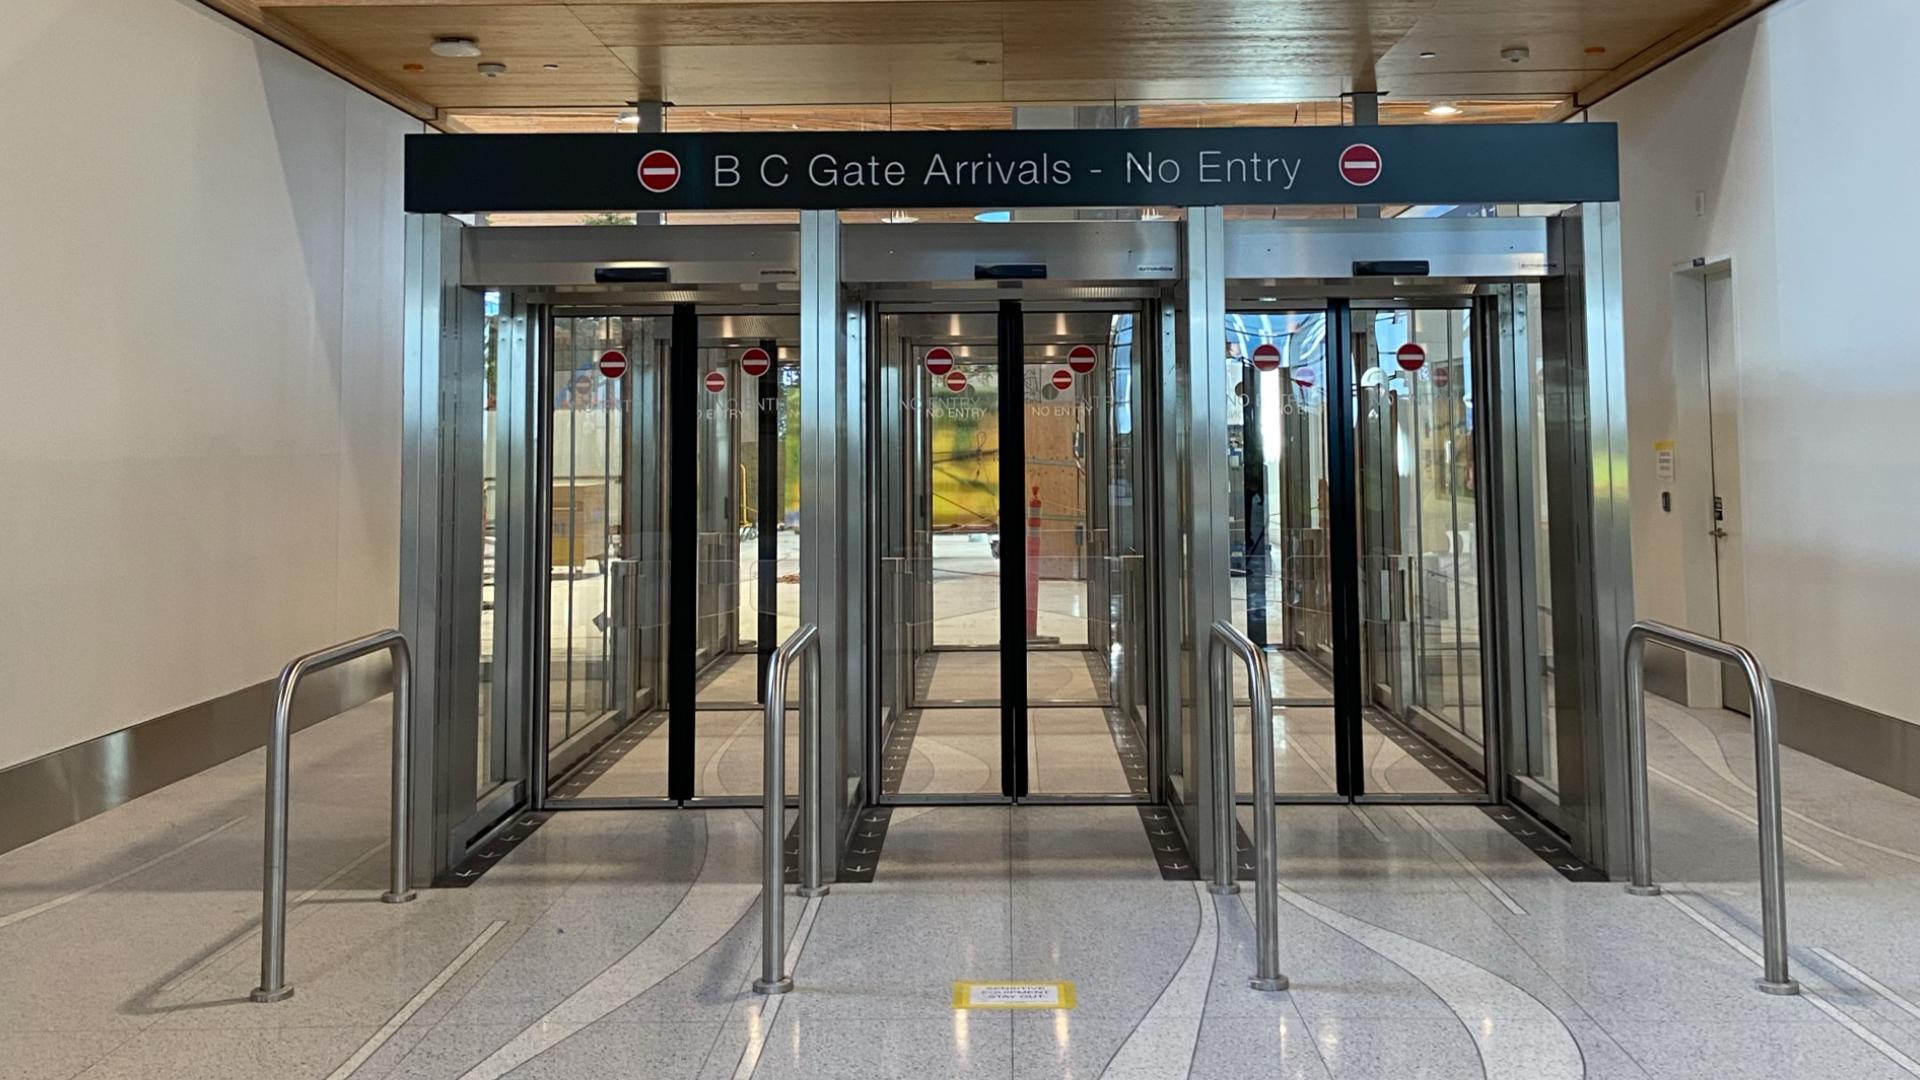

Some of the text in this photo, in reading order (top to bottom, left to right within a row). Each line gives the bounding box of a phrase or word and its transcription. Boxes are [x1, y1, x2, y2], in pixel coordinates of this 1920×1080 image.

[714, 155, 741, 187] B
[760, 154, 789, 187] C
[808, 154, 905, 187] Gate
[923, 152, 1072, 185] Arrivals
[1126, 151, 1180, 183] No
[1199, 150, 1301, 190] Entry
[928, 397, 980, 410] ENTRY
[926, 407, 987, 418] NO ENTRY
[1031, 406, 1093, 417] NO ENTRY
